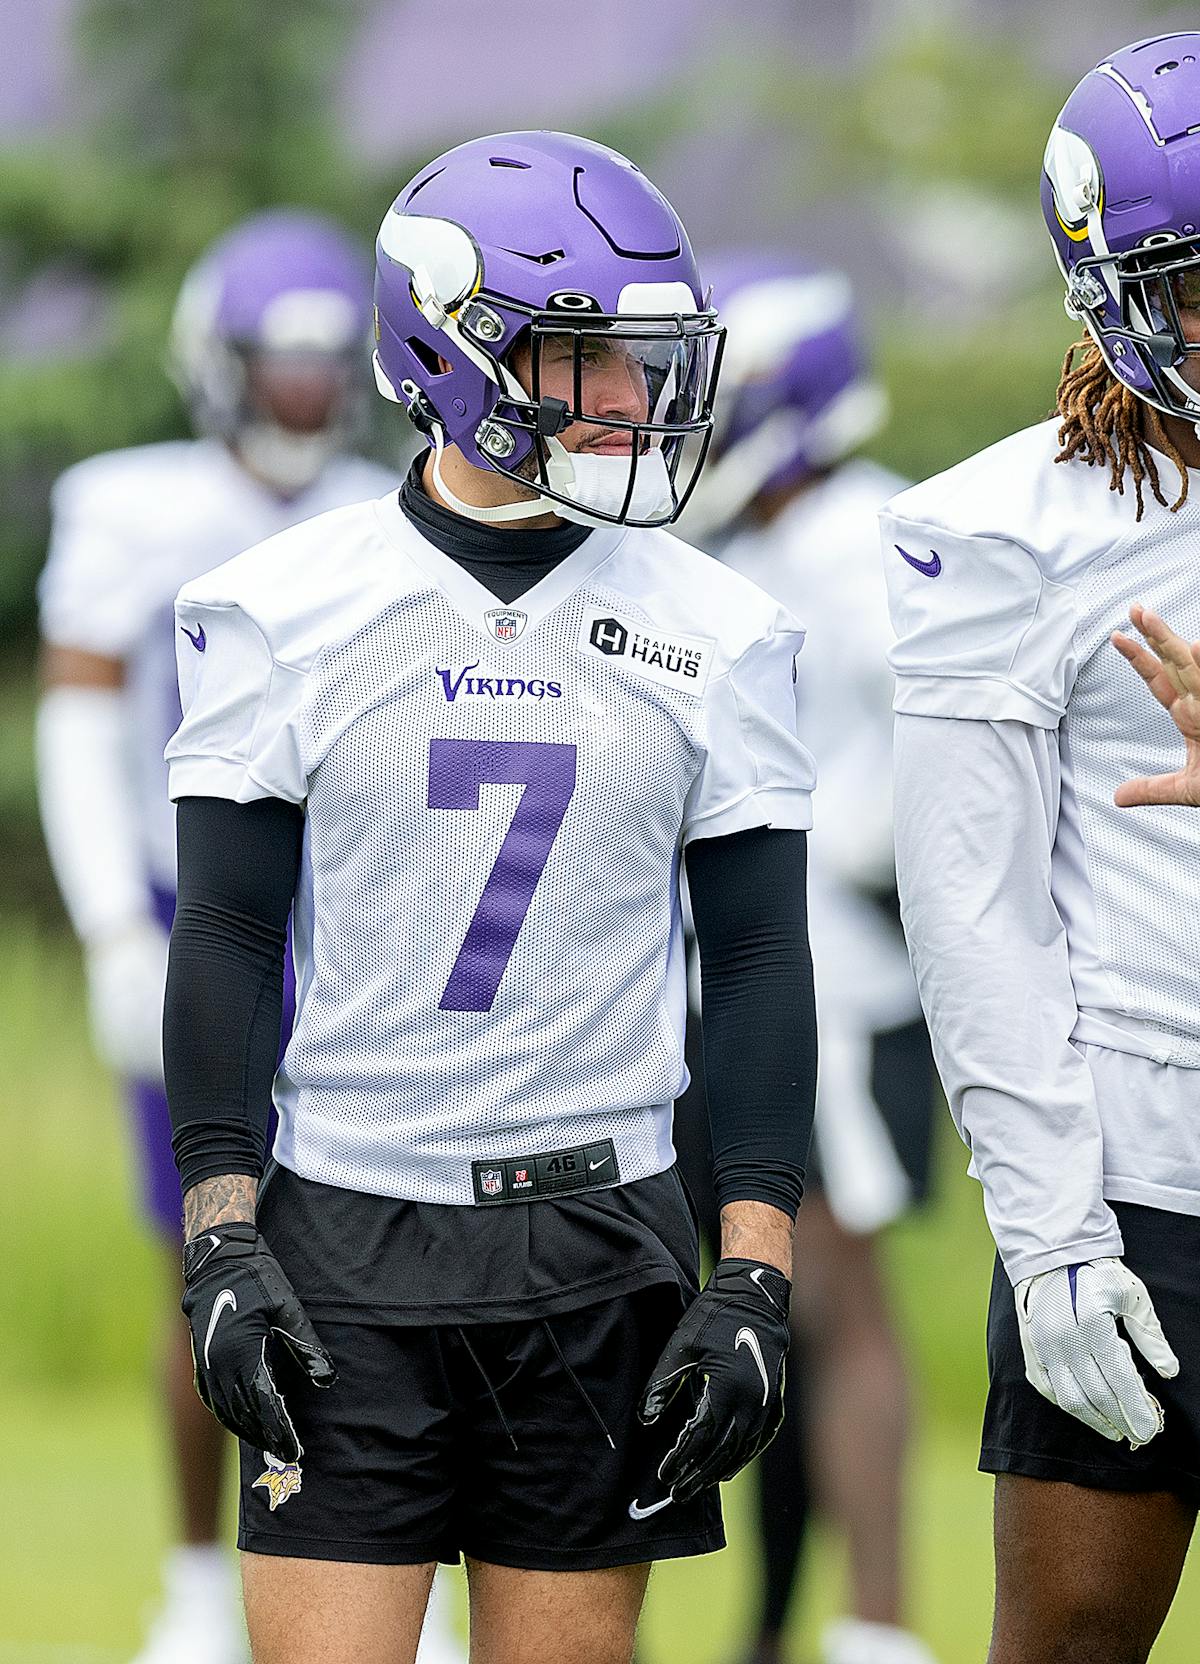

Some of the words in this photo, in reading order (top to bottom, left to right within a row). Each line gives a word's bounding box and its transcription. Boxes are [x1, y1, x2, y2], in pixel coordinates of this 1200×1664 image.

[487, 611, 525, 620] EQUIPMENT
[497, 626, 515, 638] NFL
[634, 633, 703, 661] TRAINING
[631, 643, 700, 678] HAUS
[427, 738, 578, 1013] 7
[483, 1180, 500, 1191] NFL
